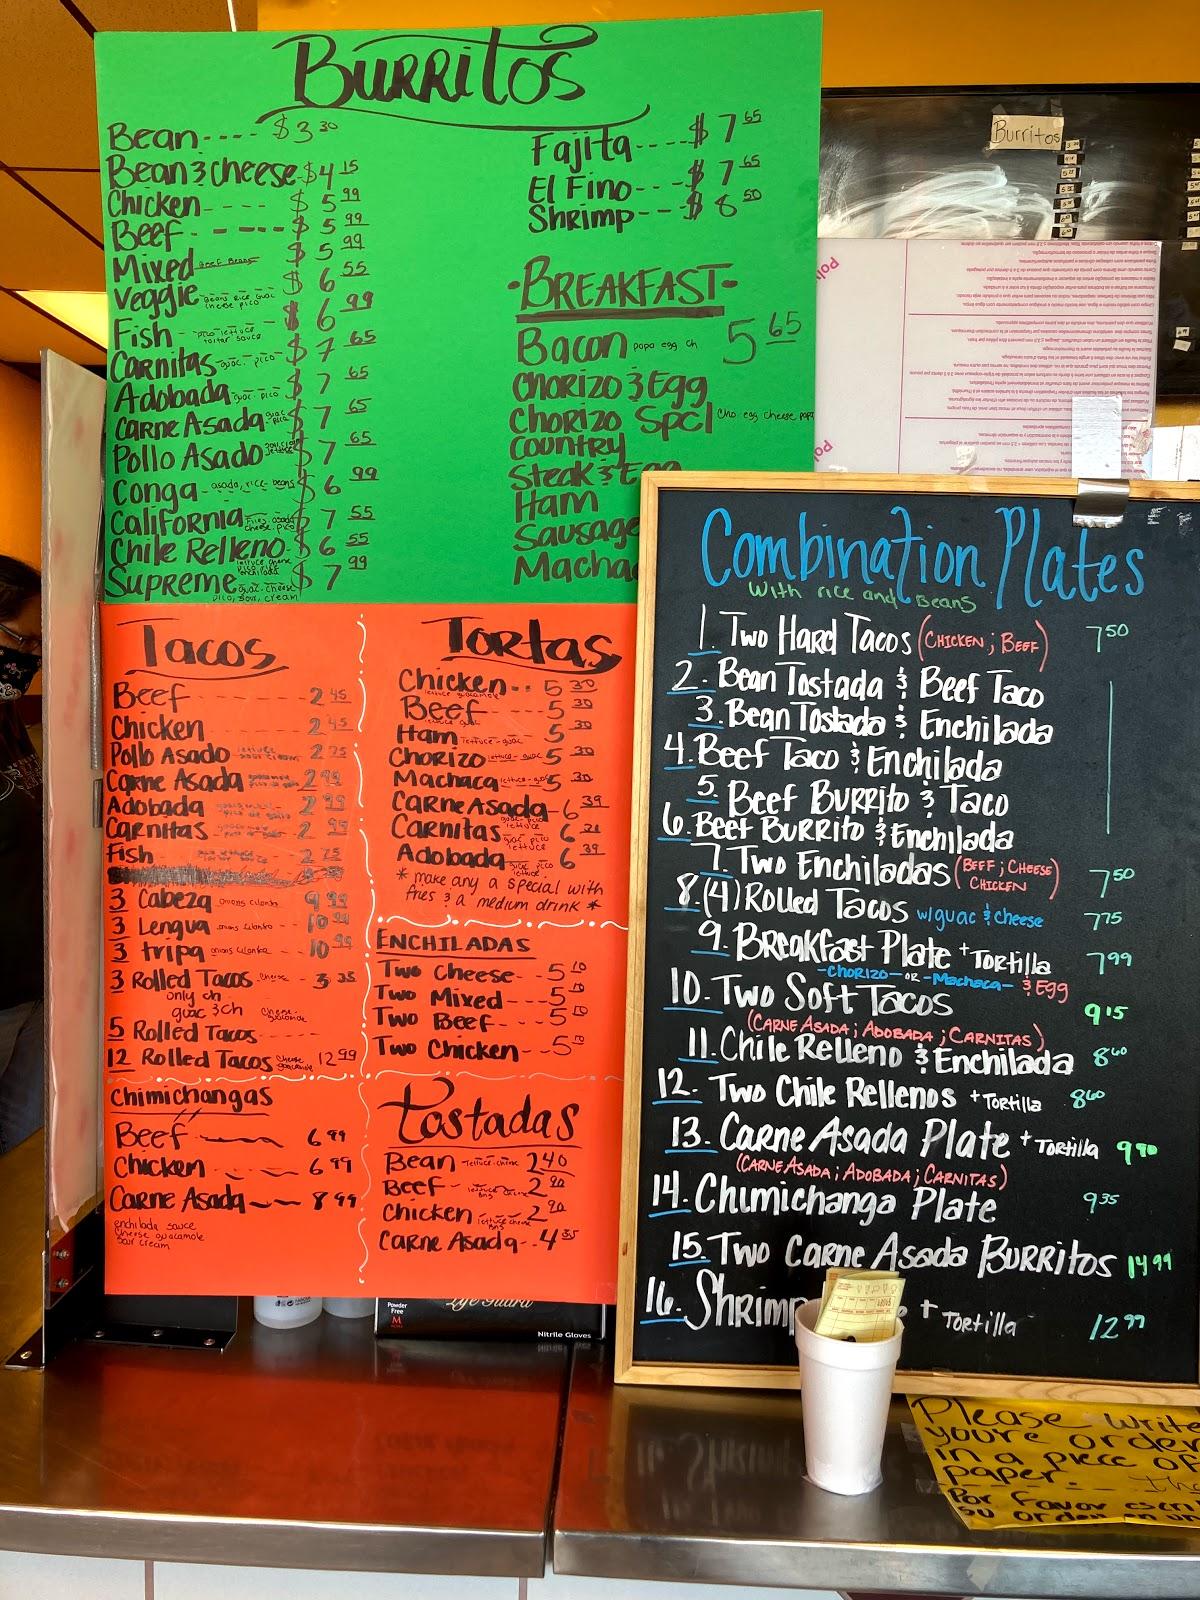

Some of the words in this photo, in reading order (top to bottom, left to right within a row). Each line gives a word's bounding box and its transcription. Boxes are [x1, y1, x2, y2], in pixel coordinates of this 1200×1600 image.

[272, 26, 586, 107] Burritos
[107, 123, 198, 151] Bean
[994, 119, 1060, 144] Burritos
[532, 127, 632, 173] Fajita
[529, 175, 554, 203] El
[567, 173, 631, 201] Fino
[107, 190, 200, 218] Chicken
[529, 204, 634, 233] Shrimp
[112, 220, 183, 252] Beef
[113, 248, 194, 283] Mixed
[520, 256, 734, 310] BREAKFAST
[114, 283, 199, 319] Veggie
[114, 319, 172, 349] Fish
[517, 327, 627, 366] Bacon
[111, 348, 216, 383] Carnitas
[114, 380, 230, 413] Adobada
[649, 370, 707, 409] Egg
[184, 408, 265, 437] Asada
[113, 444, 175, 473] Pollo
[182, 442, 263, 470] Asado
[510, 433, 625, 469] Country
[509, 461, 594, 491] Steak
[113, 480, 197, 513] Conga
[515, 490, 598, 523] Ham
[111, 507, 243, 536] California
[513, 517, 639, 551] Sausage
[109, 536, 176, 565] Chile
[187, 538, 285, 565] Relleno
[701, 506, 986, 604] Combination
[995, 506, 1144, 610] Plates
[105, 564, 237, 601] Supreme
[818, 585, 853, 599] rice
[863, 588, 898, 609] and
[117, 618, 276, 669] Tacos
[779, 614, 836, 655] Hard
[844, 613, 911, 655] Tacos
[399, 668, 506, 695] Chicken
[718, 657, 776, 693] Bean
[775, 662, 883, 700] Tostada
[988, 670, 1044, 708] Taco
[113, 682, 190, 713] Beef
[401, 695, 487, 721] Beef
[112, 711, 204, 741] Chicken
[397, 724, 457, 745] Ham
[790, 702, 886, 736] Tostada
[920, 709, 1053, 744] Enchilada
[110, 742, 154, 768] Pollo
[161, 743, 230, 765] Asado
[770, 737, 839, 770] Taco
[867, 746, 1002, 783] Enchilada
[174, 767, 244, 792] Asada
[394, 770, 498, 792] Machaca
[108, 796, 204, 817] Adobada
[467, 794, 548, 821] Asada
[940, 784, 1009, 816] Taco
[106, 817, 208, 840] Carnitas
[890, 820, 1014, 854] Enchilada
[107, 844, 153, 864] Fish
[397, 844, 505, 869] Adobada
[415, 872, 447, 886] make
[452, 875, 479, 894] any
[489, 878, 498, 889] a
[508, 879, 560, 895] special
[568, 880, 603, 895] with
[797, 850, 950, 888] Enchiladas
[139, 888, 212, 913] Cabeza
[406, 885, 435, 901] fries
[456, 895, 465, 906] a
[477, 898, 528, 910] medium
[536, 899, 579, 912] drink
[745, 882, 818, 915] Rolled
[994, 908, 1044, 928] cheese
[139, 918, 210, 940] Lengua
[377, 928, 530, 952] ENCHILADAS
[733, 923, 874, 963] Breakfast
[880, 930, 951, 969] Plate
[133, 969, 190, 992] Rolled
[196, 969, 253, 988] Tacos
[378, 960, 421, 977] Two
[434, 963, 514, 983] Cheese
[167, 991, 194, 1007] only
[374, 984, 416, 1001] Two
[431, 988, 502, 1009] Mixed
[785, 972, 859, 1014] Soft
[134, 1020, 198, 1042] Rolled
[206, 1025, 257, 1043] Tacos
[373, 1007, 418, 1026] Two
[434, 1012, 494, 1032] Beef
[142, 1048, 209, 1068] Rolled
[216, 1050, 272, 1072] Tacos
[428, 1035, 518, 1062] Chicken
[720, 1026, 790, 1063] Chile
[795, 1032, 902, 1067] Relleno
[933, 1048, 1074, 1076] Enchilada
[776, 1075, 836, 1107] Chile
[846, 1077, 957, 1109] Rellenos
[116, 1122, 187, 1149] Beef
[920, 1118, 1010, 1160] Plate
[384, 1152, 455, 1174] Bean
[181, 1184, 245, 1213] Asada
[383, 1199, 472, 1224] Chicken
[911, 1186, 997, 1223] Plate
[167, 1222, 196, 1230] sauce
[392, 1316, 401, 1325] M
[565, 1331, 591, 1339] Gloves
[911, 1397, 1092, 1431] Please
[995, 1452, 1023, 1465] a
